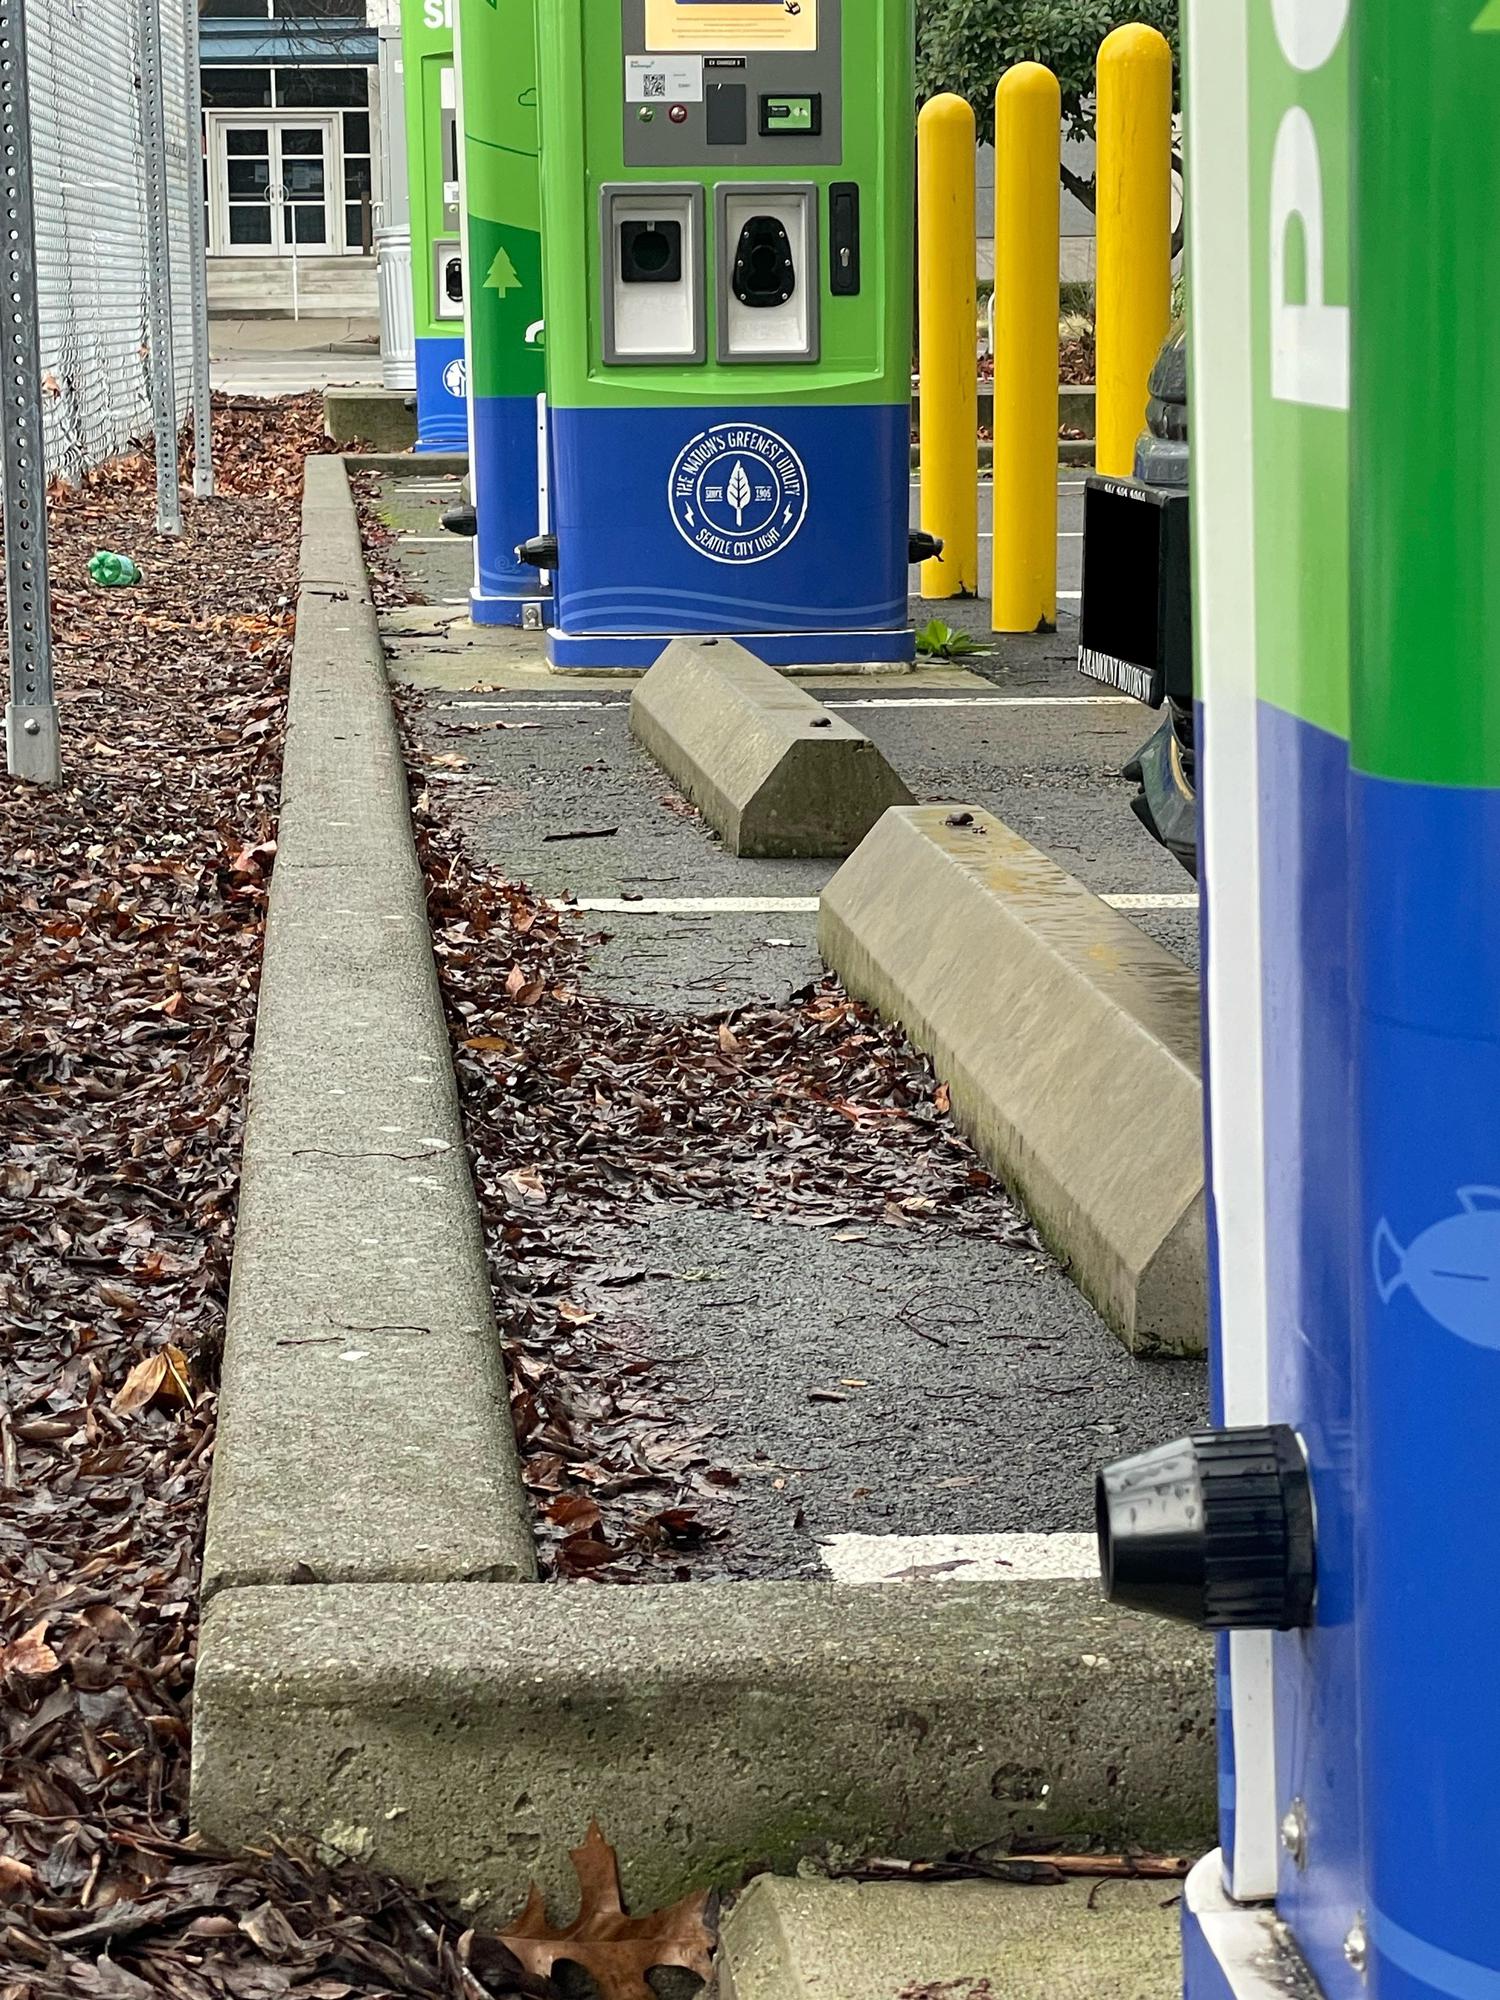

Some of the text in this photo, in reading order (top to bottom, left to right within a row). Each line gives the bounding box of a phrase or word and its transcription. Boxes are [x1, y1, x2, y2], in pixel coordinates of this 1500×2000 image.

[676, 431, 801, 497] THE NATION'S GREENEST UTILITY
[695, 527, 781, 556] SEATTLE CITY LIGHT
